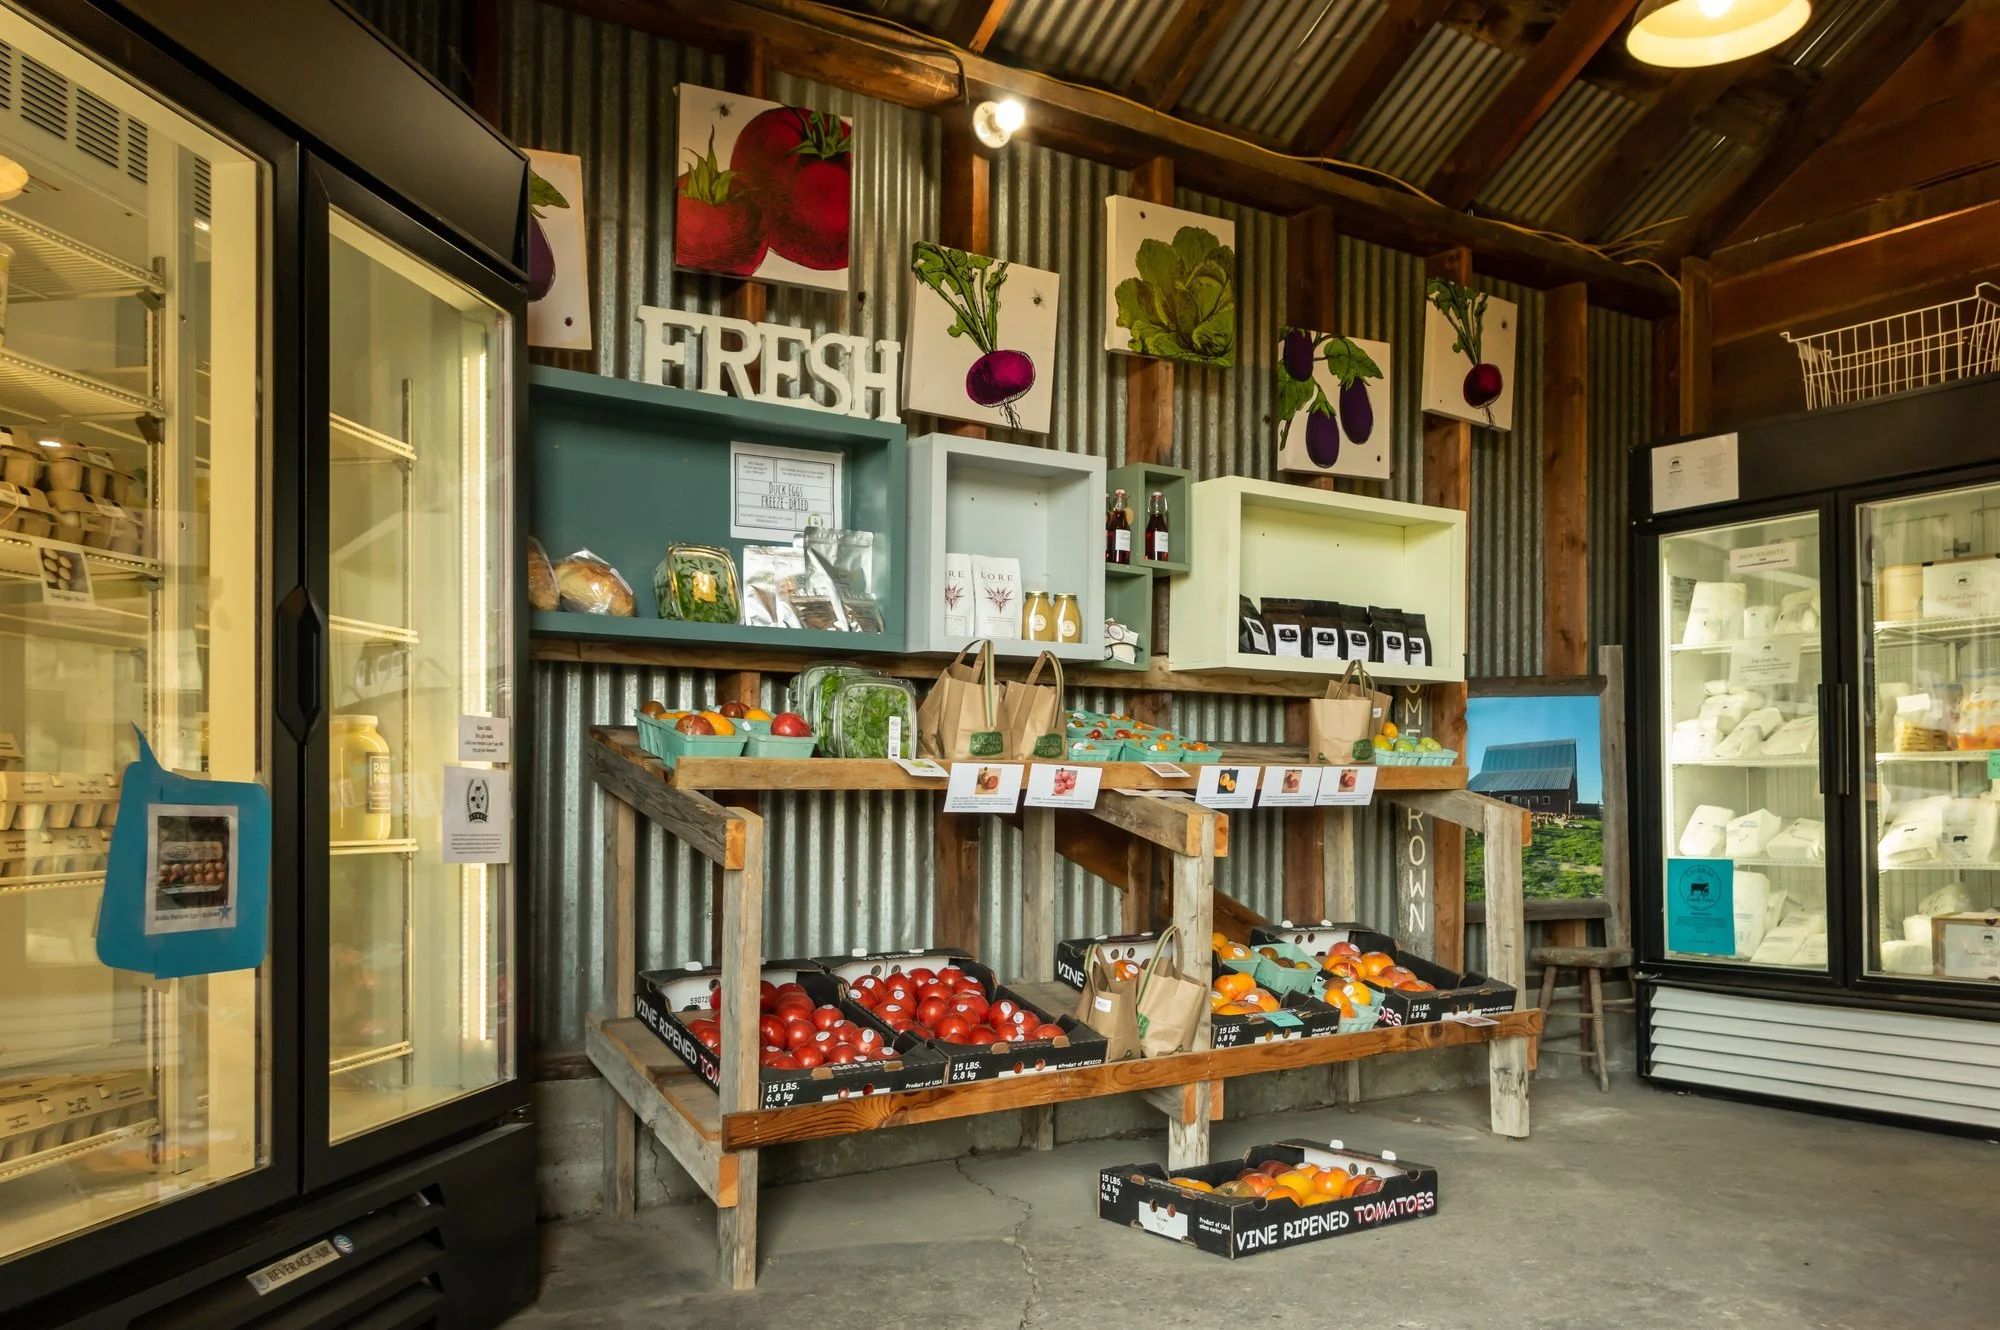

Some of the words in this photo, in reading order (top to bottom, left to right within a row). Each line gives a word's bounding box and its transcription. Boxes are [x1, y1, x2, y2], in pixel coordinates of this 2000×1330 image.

[637, 305, 901, 424] FRESH
[761, 496, 808, 512] FREEZE-DRIED
[948, 570, 965, 578] RE
[980, 571, 1014, 582] LORE
[1407, 808, 1426, 932] ROWN
[1057, 960, 1084, 988] VINE
[1379, 1005, 1402, 1026] OES
[636, 995, 658, 1029] VINE
[659, 1016, 697, 1064] RIPENED
[700, 1054, 720, 1086] TOM
[1217, 1034, 1228, 1042] 6.8
[1229, 1034, 1237, 1042] kg
[952, 1072, 965, 1080] 6.8
[967, 1070, 976, 1080] kg
[767, 1084, 779, 1093] 15
[780, 1082, 800, 1090] LBS.
[766, 1093, 781, 1103] 6.8
[783, 1092, 794, 1102] kg
[1102, 1174, 1108, 1182] 15
[1110, 1176, 1122, 1186] LBS.
[1102, 1183, 1111, 1192] 6.8
[1112, 1184, 1119, 1196] kg
[1101, 1192, 1111, 1202] No.
[1200, 1216, 1214, 1226] Product
[1236, 1224, 1278, 1251] VINE
[1284, 1211, 1349, 1240] RIPENED
[1354, 1192, 1434, 1224] TOMATOES
[266, 1246, 334, 1282] BEVERAGE-AIR
